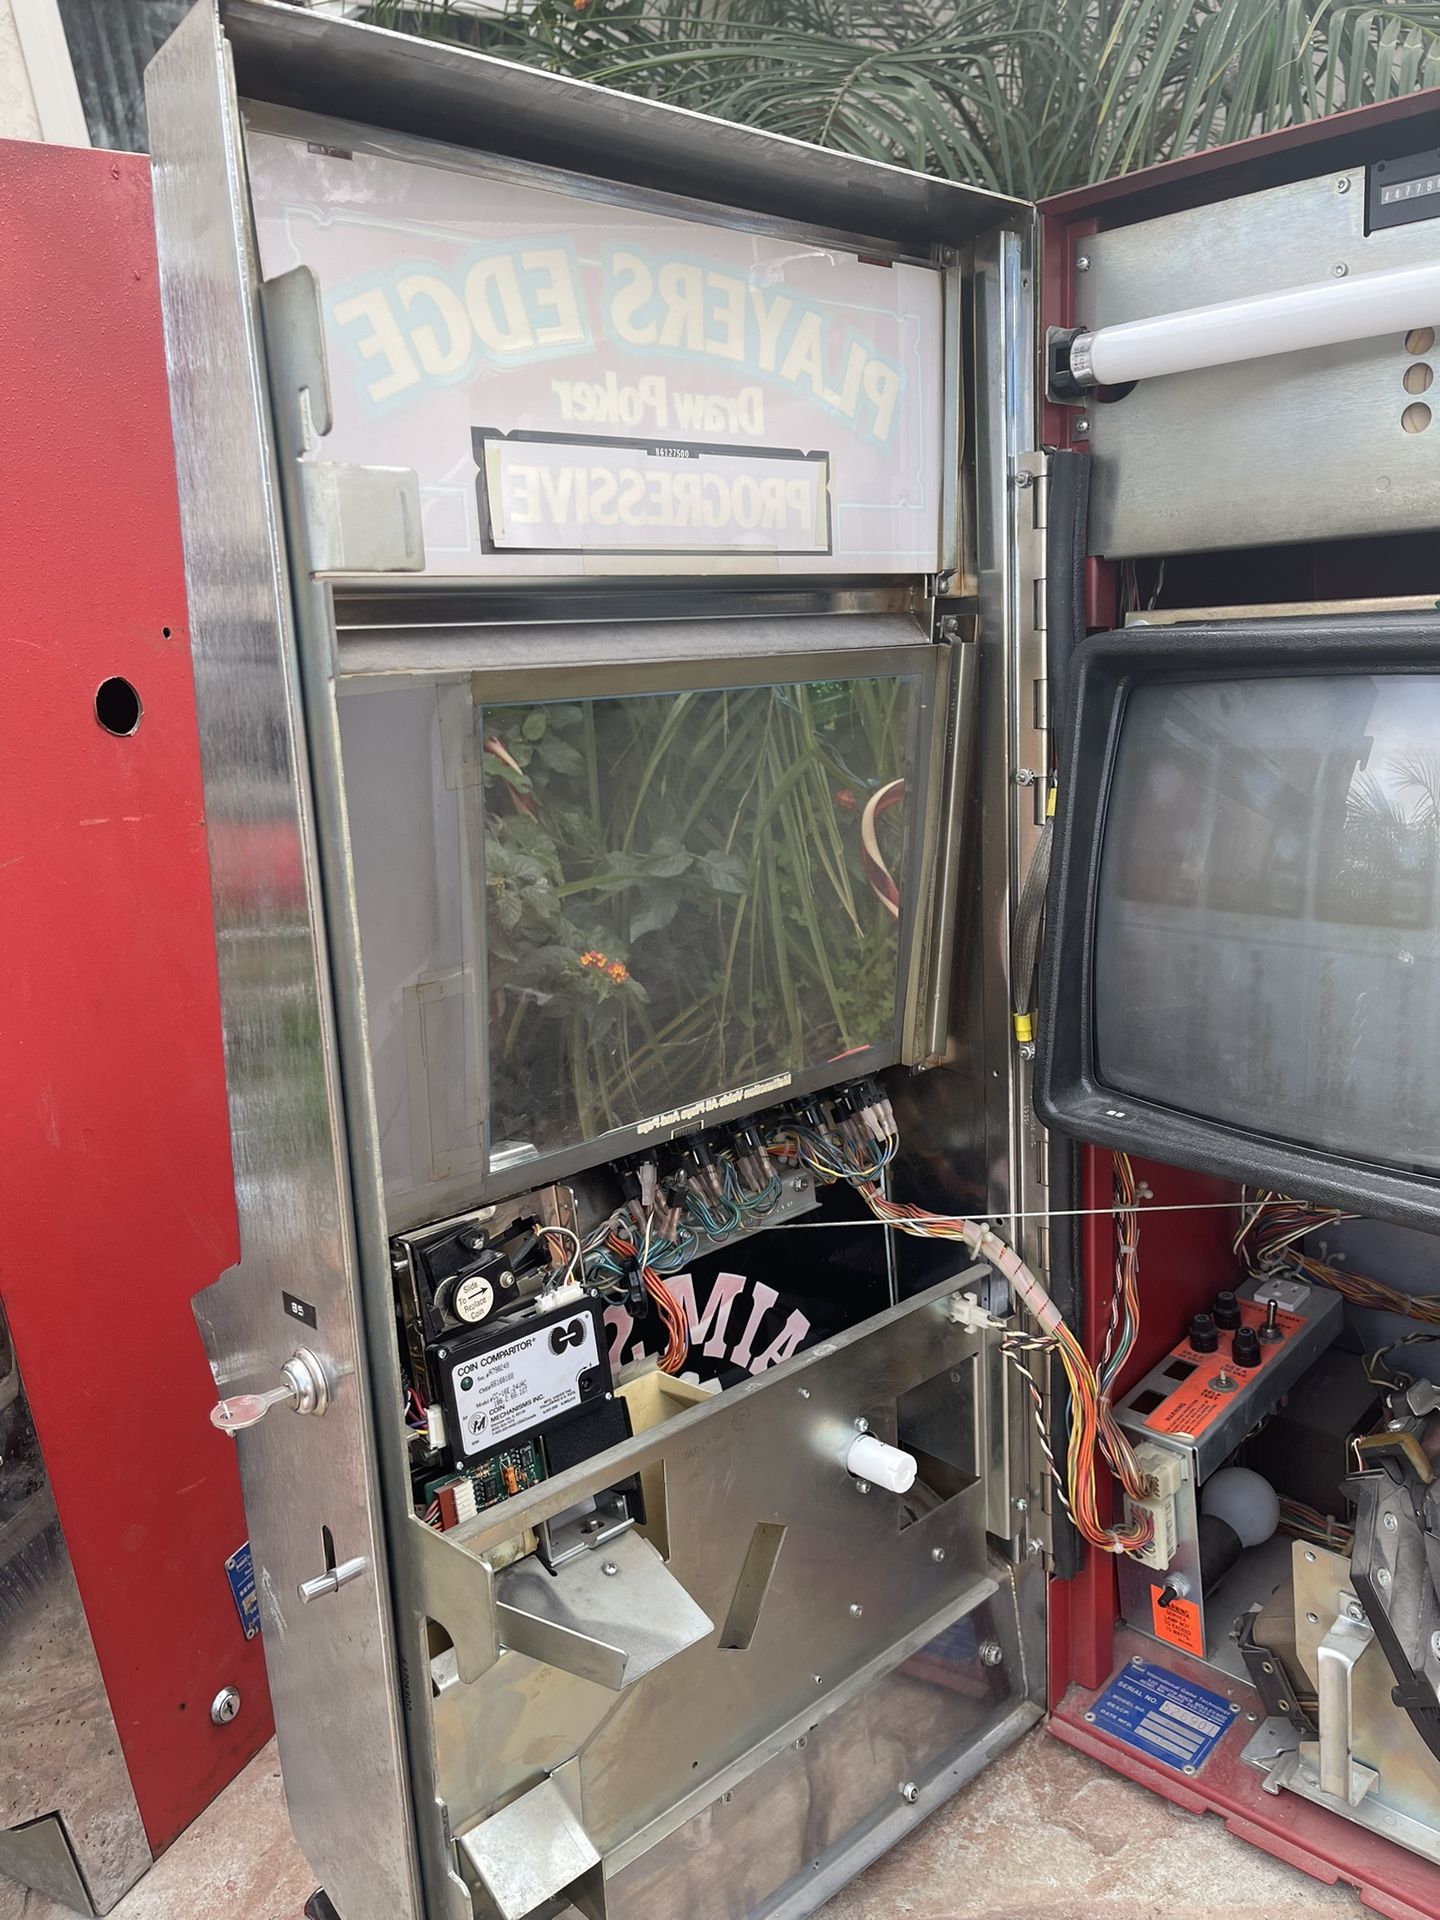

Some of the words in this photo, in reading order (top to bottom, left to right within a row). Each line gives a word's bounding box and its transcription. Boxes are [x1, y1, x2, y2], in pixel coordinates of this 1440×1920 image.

[655, 447, 690, 458] 86127500
[463, 1282, 478, 1293] Slide
[464, 1297, 486, 1313] Replace
[471, 1308, 484, 1319] Coin
[458, 1360, 478, 1377] COIN
[489, 1404, 505, 1416] COIN
[491, 1398, 532, 1422] MECHANISMS
[1146, 1670, 1181, 1691] International
[1180, 1686, 1197, 1698] Game
[1117, 1680, 1142, 1697] SERIAL
[1144, 1693, 1158, 1704] NO.
[1112, 1694, 1132, 1708] MODEL
[1100, 1708, 1118, 1721] DATE
